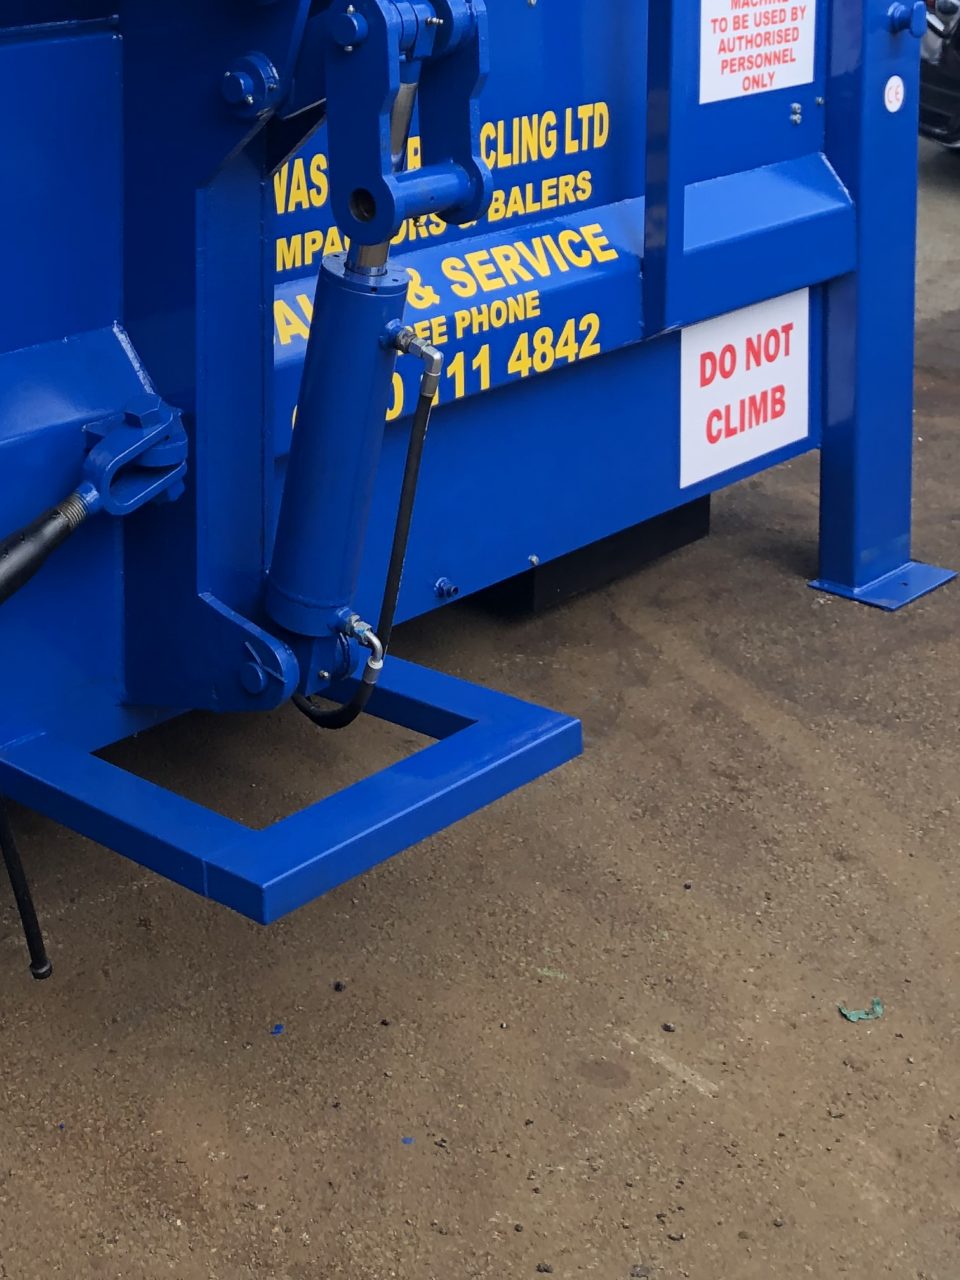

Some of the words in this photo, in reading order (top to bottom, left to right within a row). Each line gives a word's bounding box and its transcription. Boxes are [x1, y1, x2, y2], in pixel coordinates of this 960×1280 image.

[711, 18, 728, 34] TO
[733, 14, 749, 30] BE
[754, 9, 786, 27] USED
[791, 6, 807, 20] BY
[718, 27, 800, 55] AUTHORISED
[721, 49, 796, 75] PERSONNEL
[742, 72, 776, 92] ONLY
[565, 101, 610, 155] LTD
[487, 170, 593, 223] BALERS
[405, 267, 440, 310] &
[441, 223, 620, 298] SERVICE
[454, 289, 541, 340] PHONE
[507, 312, 602, 378] 4842
[699, 344, 737, 388] DO
[745, 322, 794, 371] NOT
[705, 384, 786, 445] CLIMB
